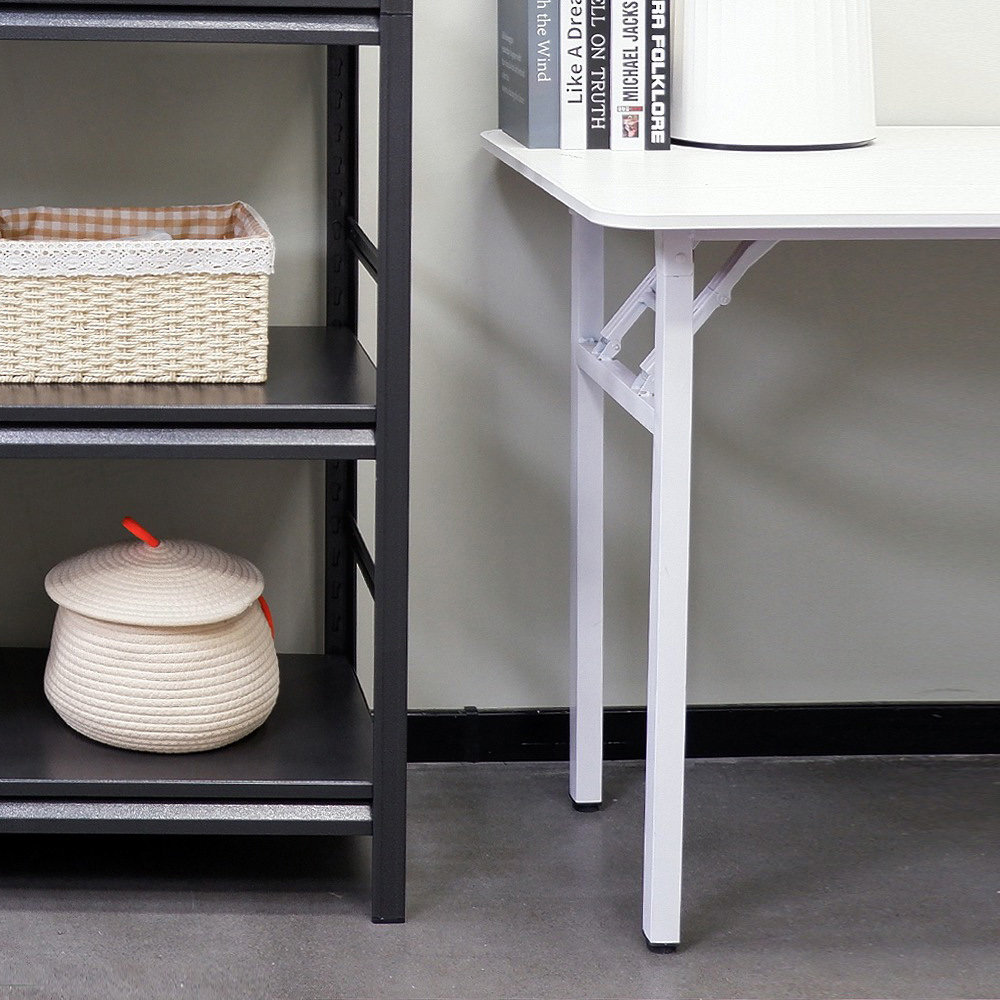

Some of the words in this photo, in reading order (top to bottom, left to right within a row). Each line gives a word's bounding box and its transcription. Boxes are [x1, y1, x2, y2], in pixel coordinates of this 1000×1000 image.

[537, 13, 551, 37] the
[538, 40, 551, 82] Wind
[568, 46, 583, 58] A
[591, 36, 606, 60] ON
[567, 64, 583, 104] Like
[622, 47, 638, 102] MICHAEL
[651, 34, 665, 143] FOLKLORE
[591, 66, 606, 130] TRUTH
